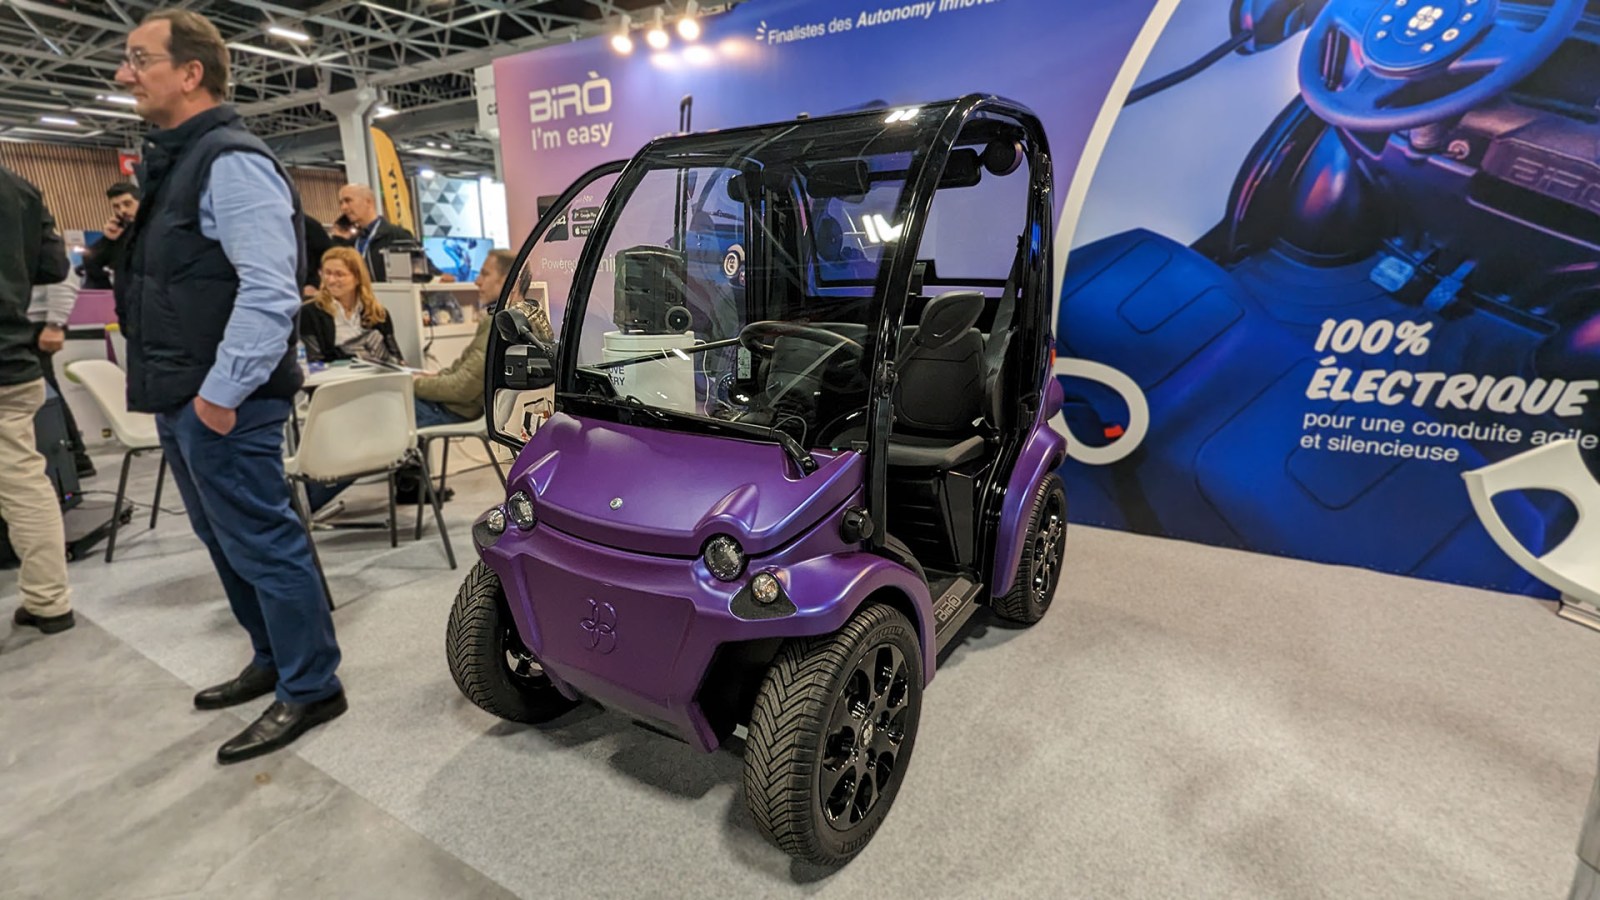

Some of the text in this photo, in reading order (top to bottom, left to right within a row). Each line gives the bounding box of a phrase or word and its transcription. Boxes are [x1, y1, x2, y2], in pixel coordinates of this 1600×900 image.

[768, 22, 825, 45] Finalistes
[828, 17, 852, 34] des
[856, 1, 935, 28] Autonomy
[531, 122, 613, 150] I'm easy
[1314, 318, 1433, 356] 100%
[1305, 355, 1600, 417] ÉLECTRIQUE
[1303, 412, 1355, 430] pour
[1361, 417, 1405, 434] une
[1412, 421, 1522, 444] conduite
[1300, 433, 1460, 462] et silencieuse
